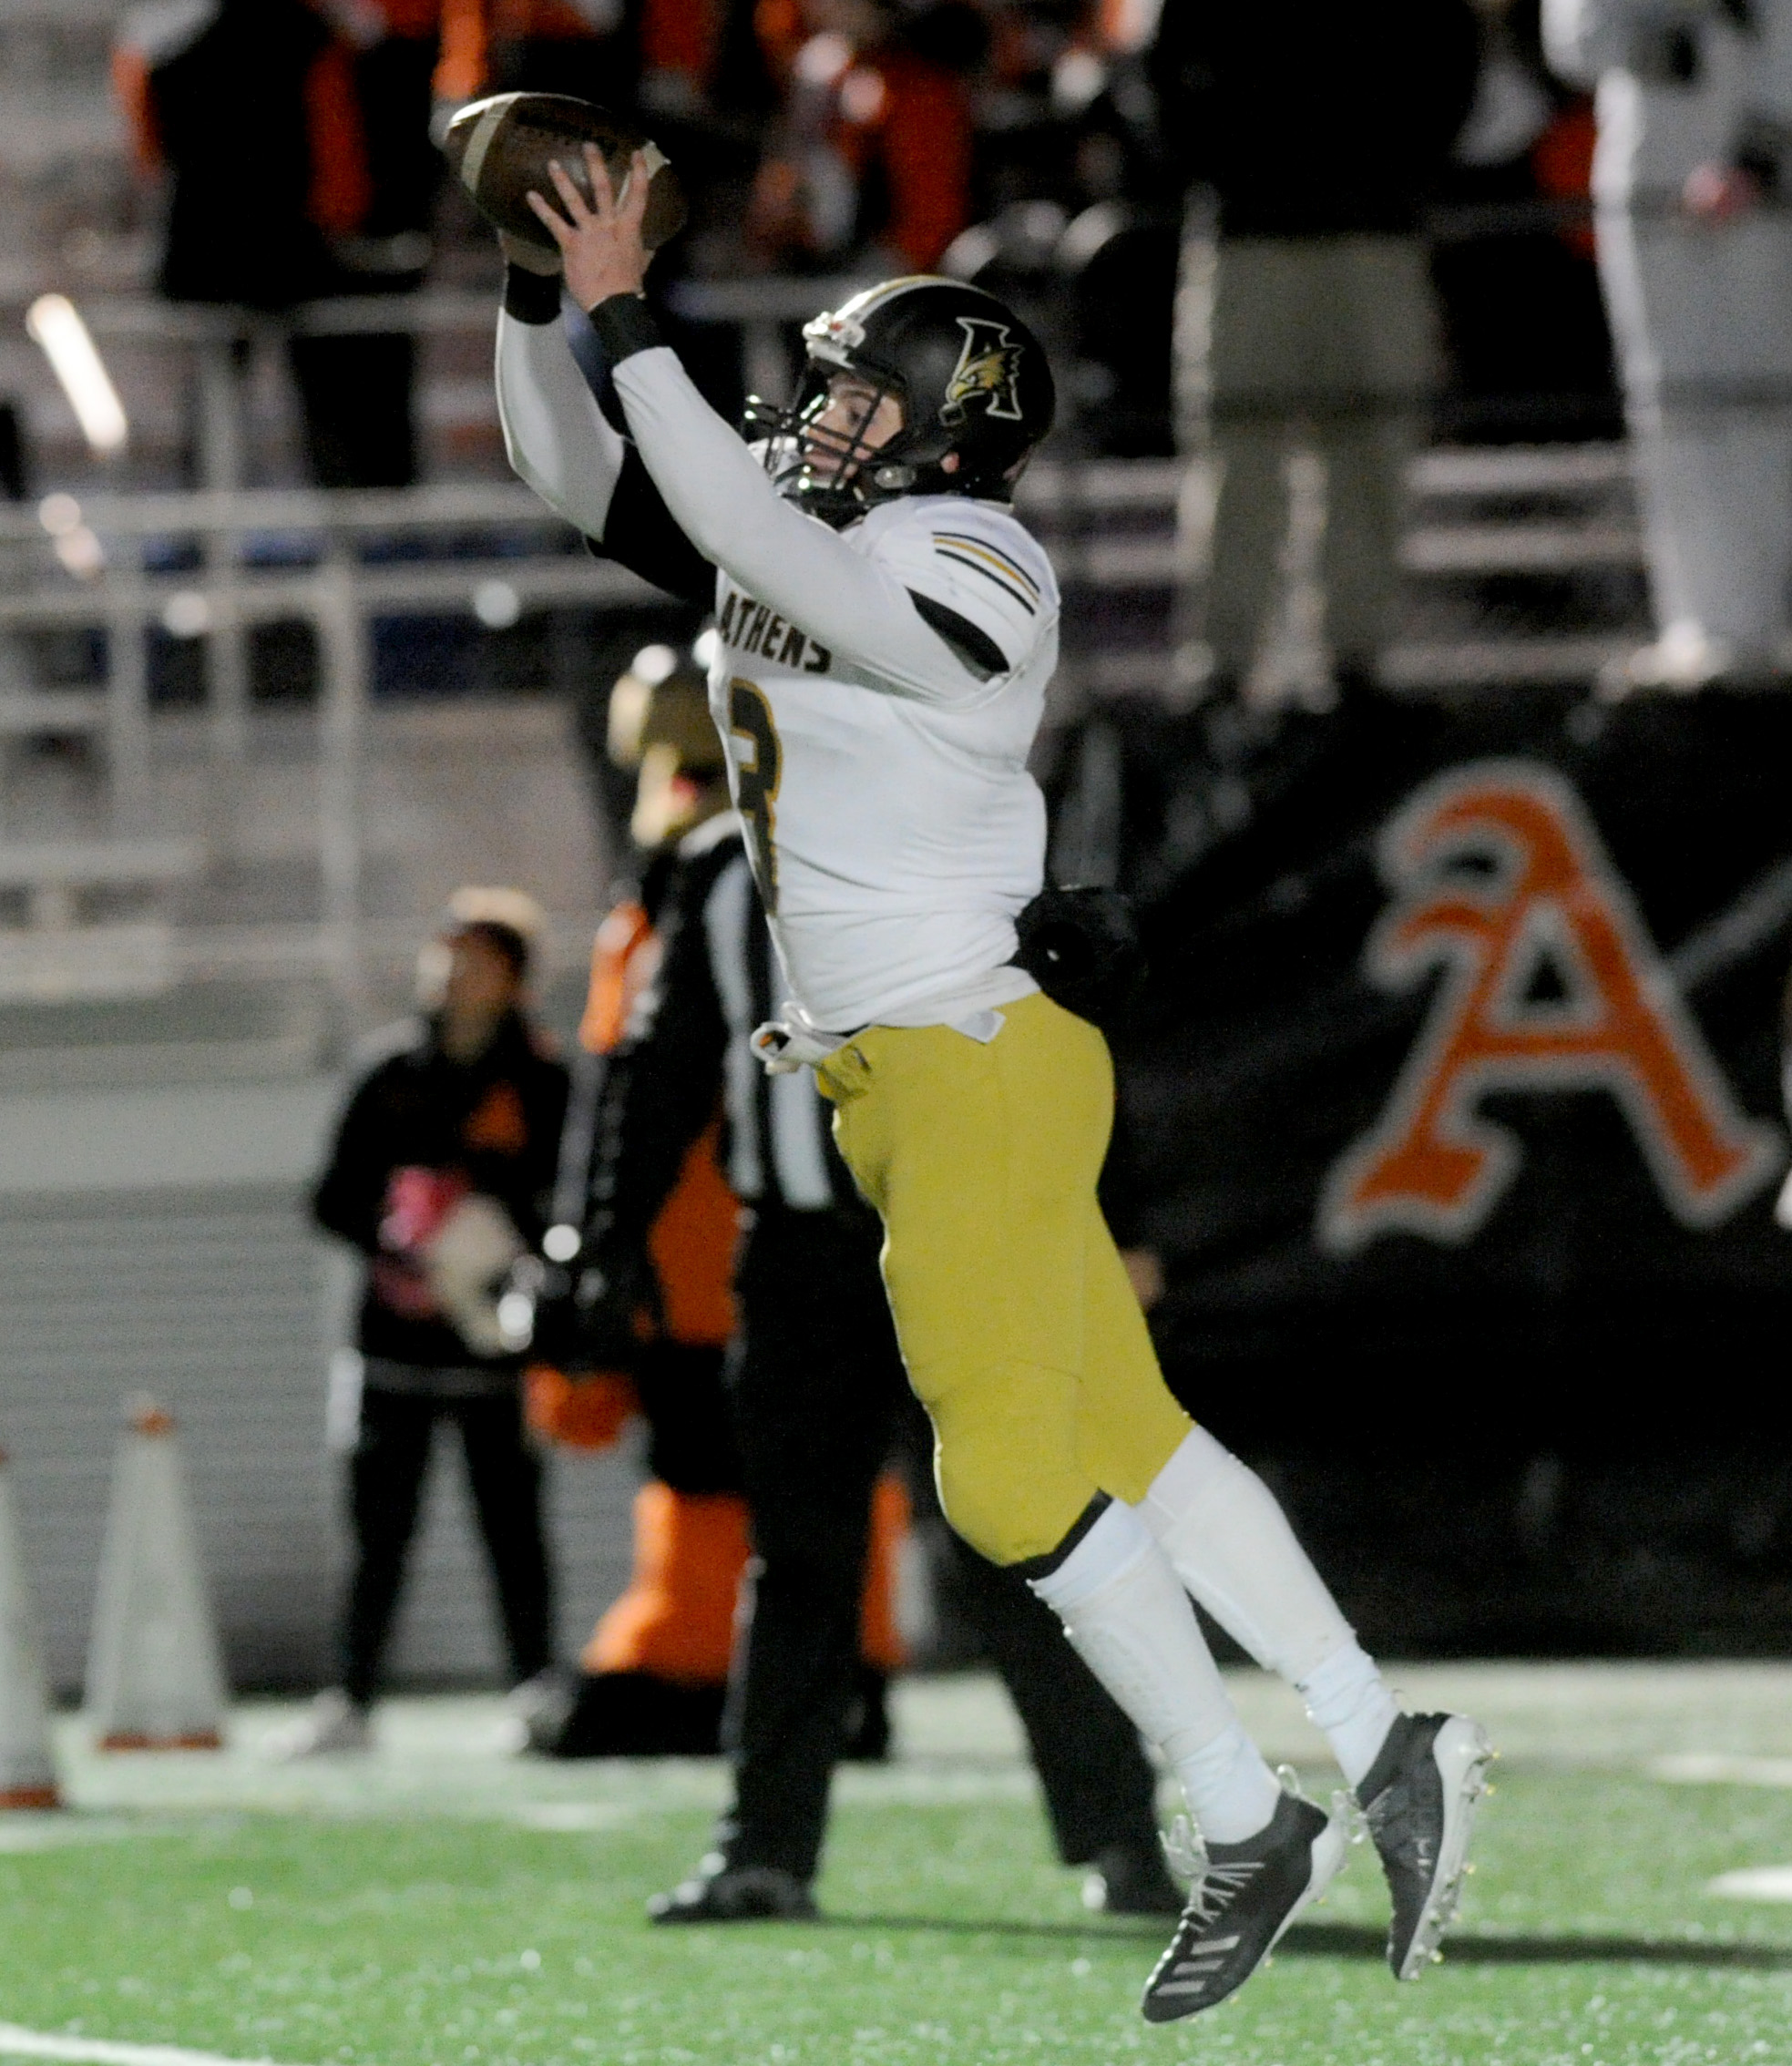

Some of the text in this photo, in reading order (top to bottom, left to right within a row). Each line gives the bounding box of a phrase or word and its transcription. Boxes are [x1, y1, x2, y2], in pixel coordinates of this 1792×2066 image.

[946, 317, 1025, 421] A
[721, 591, 831, 674] ATHENS
[1318, 758, 1783, 1251] A
